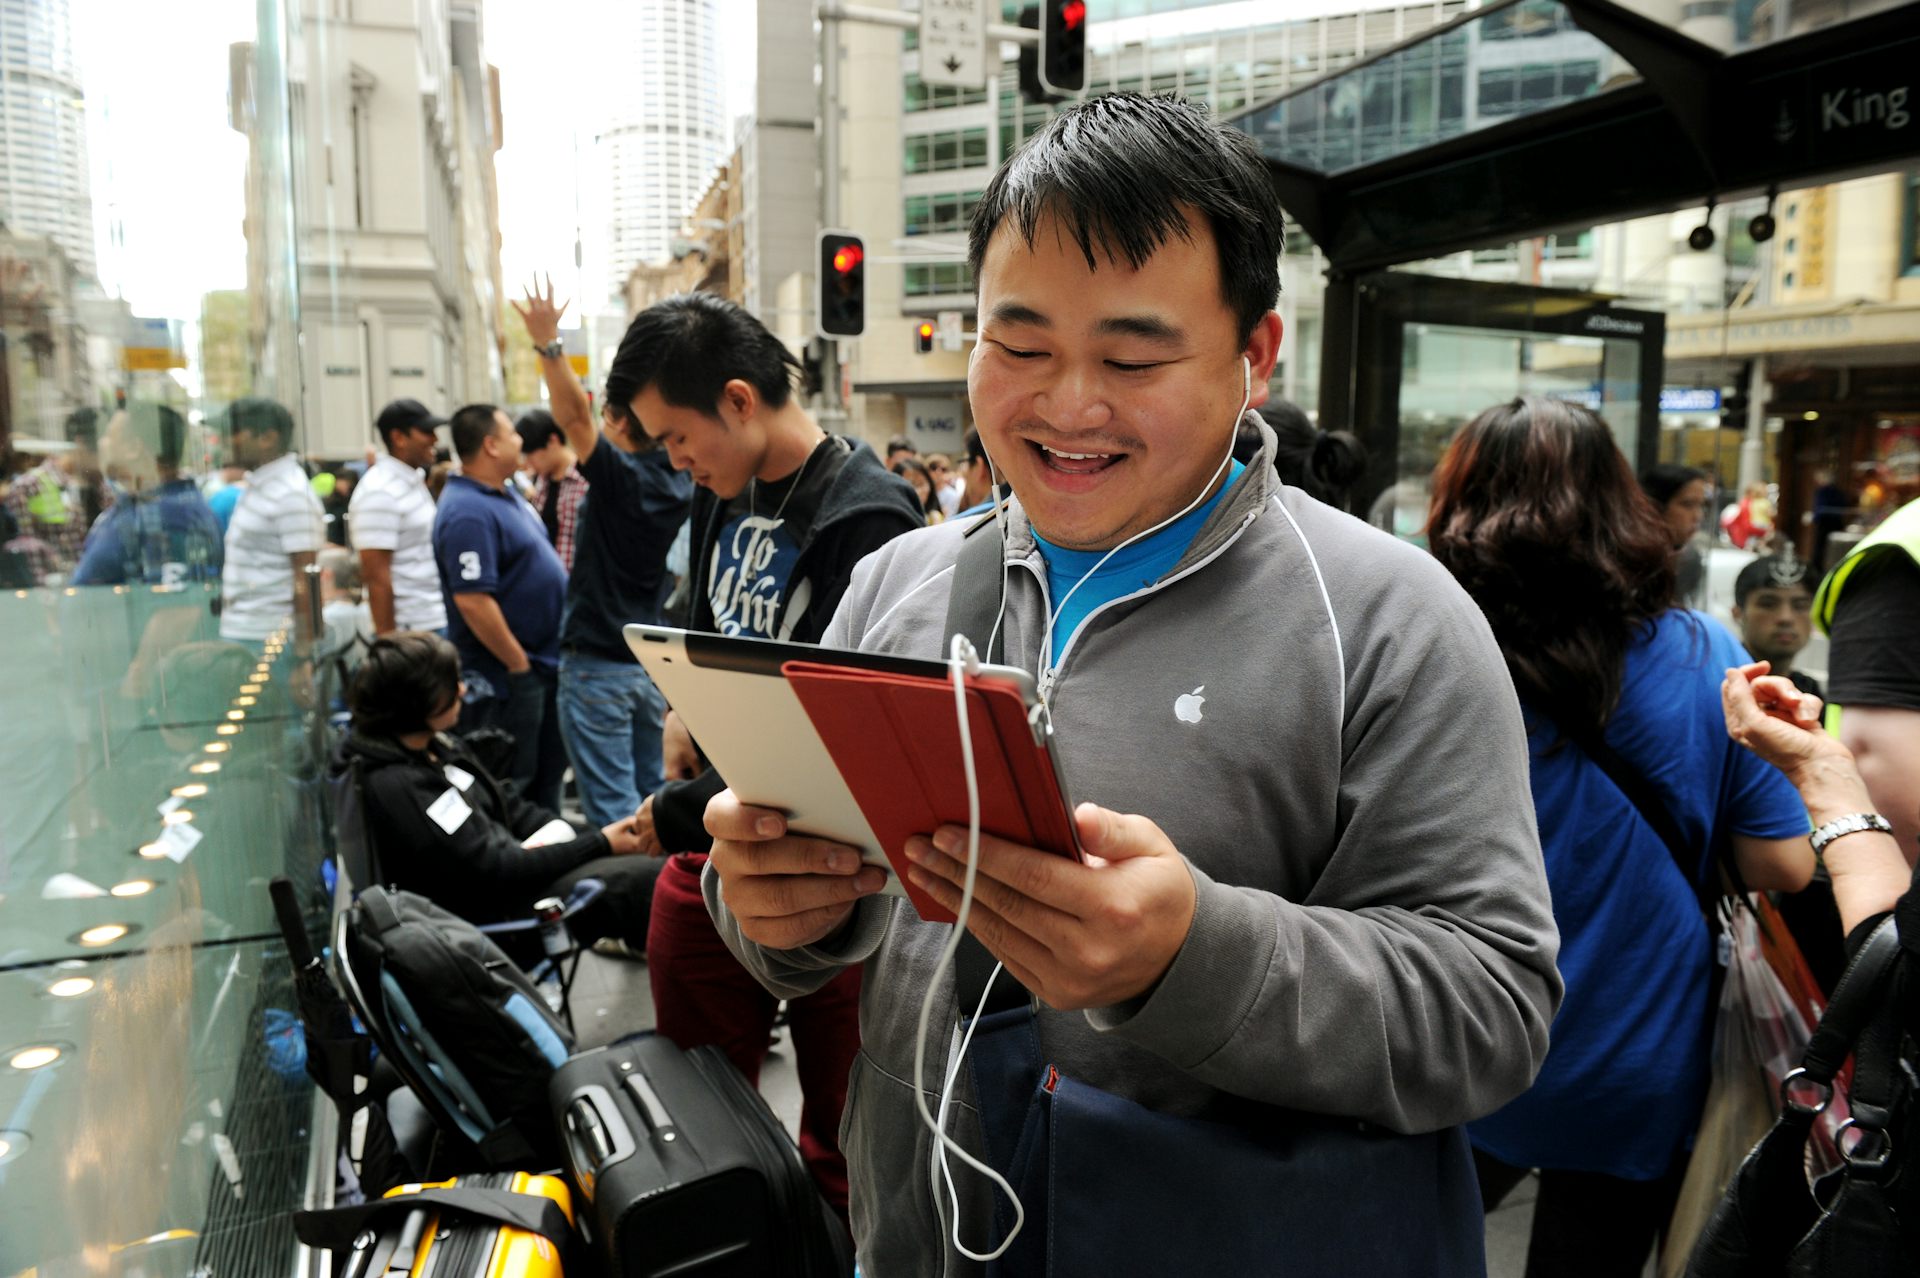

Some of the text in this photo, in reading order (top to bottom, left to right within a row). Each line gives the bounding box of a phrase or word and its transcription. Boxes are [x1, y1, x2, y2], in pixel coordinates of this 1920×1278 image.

[1821, 86, 1910, 131] King
[459, 551, 481, 580] 3
[732, 516, 784, 587] To
